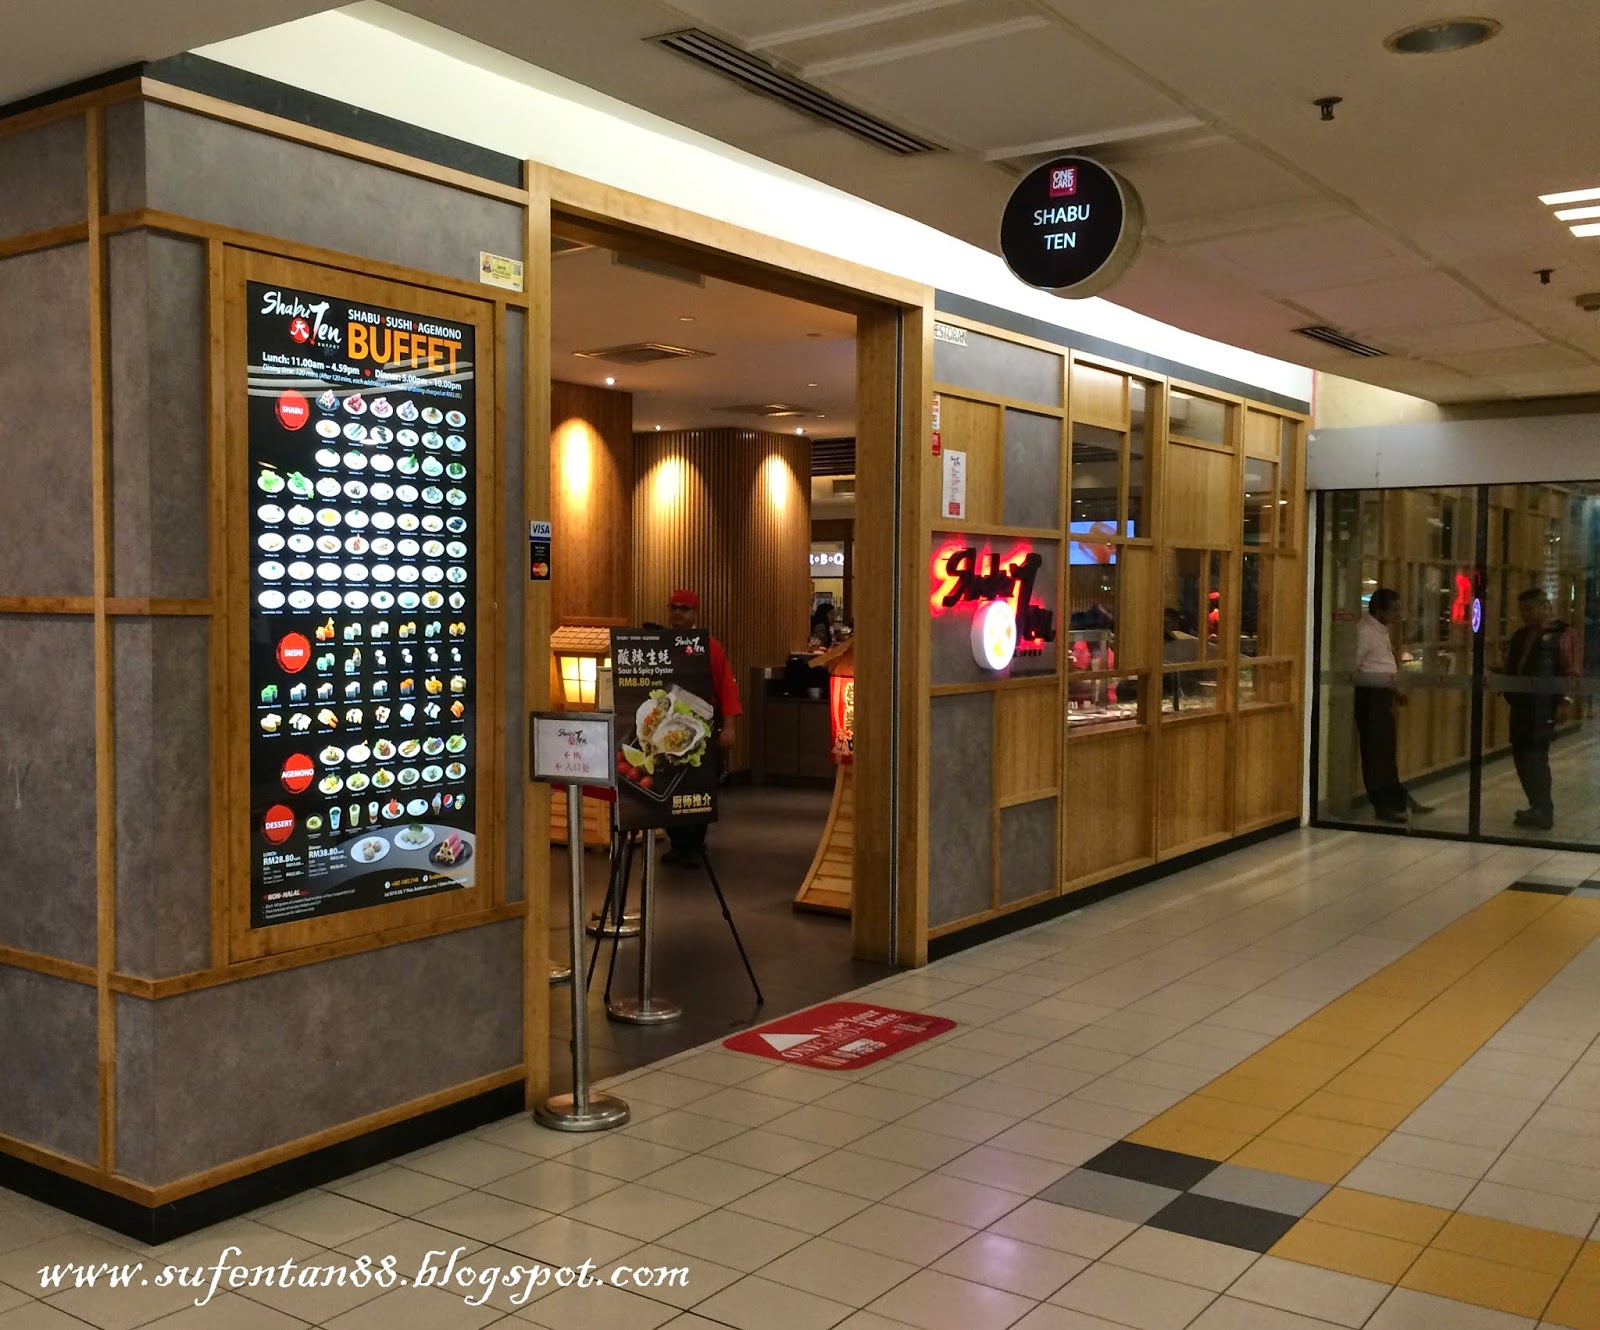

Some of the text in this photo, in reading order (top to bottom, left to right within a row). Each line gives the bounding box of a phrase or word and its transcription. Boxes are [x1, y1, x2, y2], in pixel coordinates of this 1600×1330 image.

[1052, 169, 1074, 181] ONE
[1052, 178, 1073, 189] CARD
[1033, 204, 1090, 226] SHABU
[1044, 232, 1076, 250] TEN
[261, 291, 342, 343] Shabu Ten
[348, 309, 462, 340] SHABU SUSHI AGEMONO
[934, 323, 967, 345] ESTORAN
[348, 322, 462, 375] BUFFET
[262, 352, 290, 365] Lunch:
[291, 357, 325, 370] 11.00am
[331, 363, 360, 376] 4.59pm
[375, 369, 401, 382] Dinner:
[402, 374, 427, 387] 5.00pm
[434, 379, 462, 391] 10.00pm
[532, 524, 550, 535] VISA
[285, 649, 303, 657] SUSHI
[617, 648, 672, 666] 酸辣生蚝
[618, 667, 632, 675] Sour
[638, 667, 654, 676] Spicy
[654, 667, 674, 676] Oyster
[618, 677, 650, 687] RM8.80
[573, 752, 582, 760] IN
[282, 769, 314, 779] AGEMONO
[565, 763, 590, 773] 入口处
[265, 819, 293, 830] DESSERT
[308, 847, 338, 859] RM38.80
[263, 854, 294, 866] RM28.80
[839, 1009, 880, 1023] Your
[859, 1013, 901, 1028] Here
